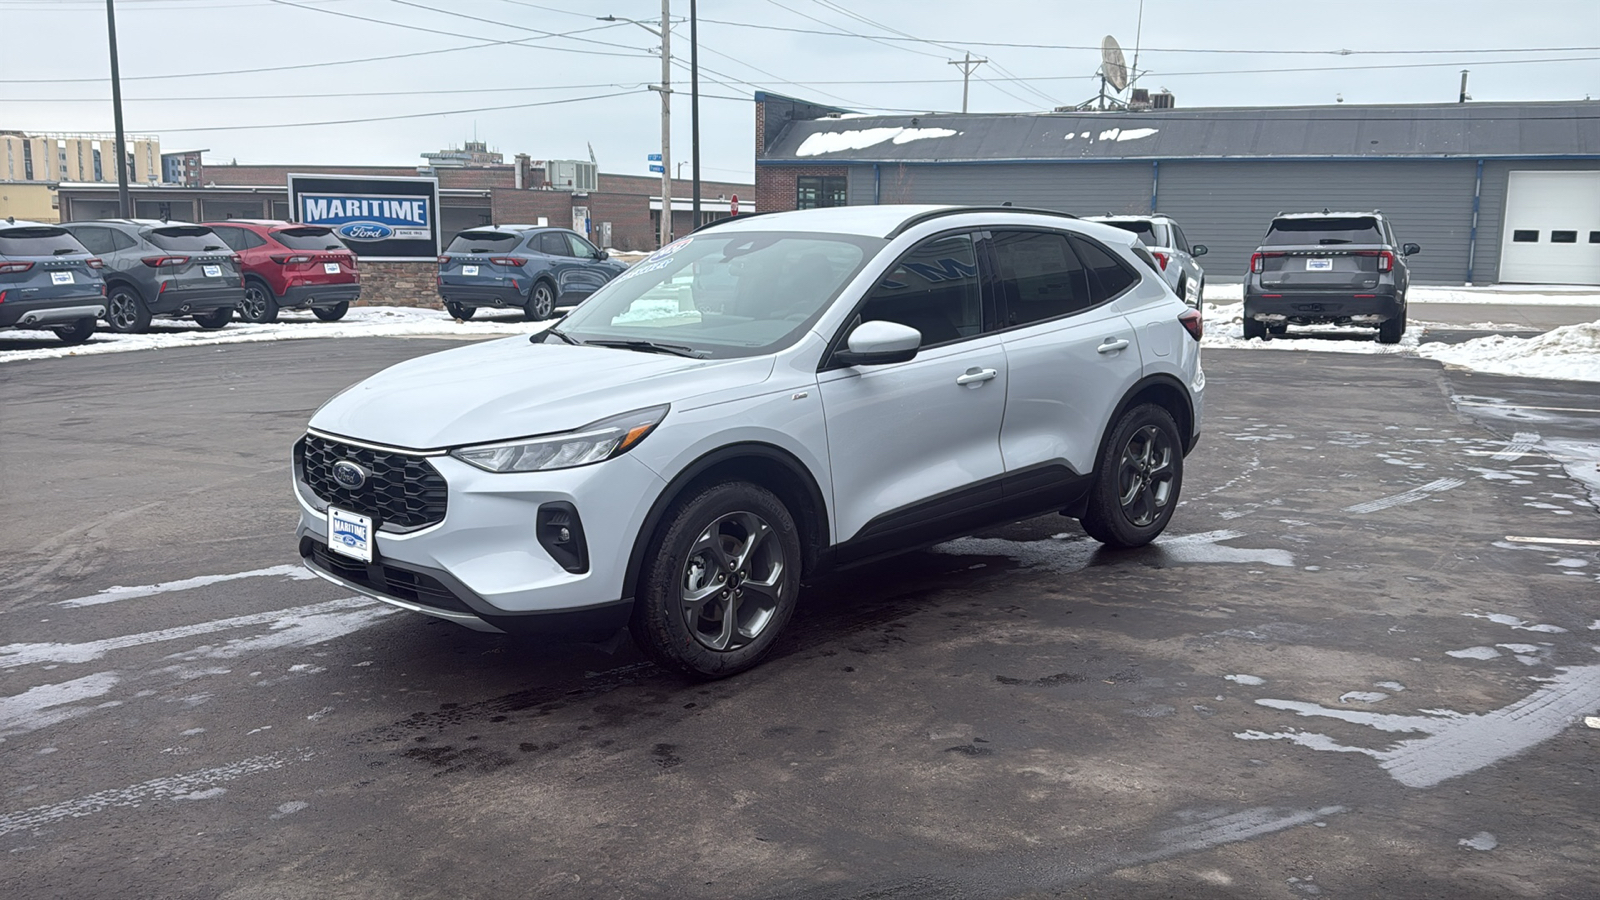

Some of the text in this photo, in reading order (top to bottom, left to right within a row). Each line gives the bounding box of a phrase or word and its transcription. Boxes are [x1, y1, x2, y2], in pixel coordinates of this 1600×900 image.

[305, 199, 424, 224] MARITIME
[350, 225, 382, 239] Ford
[338, 466, 356, 483] Ford
[334, 519, 367, 541] MARITIME
